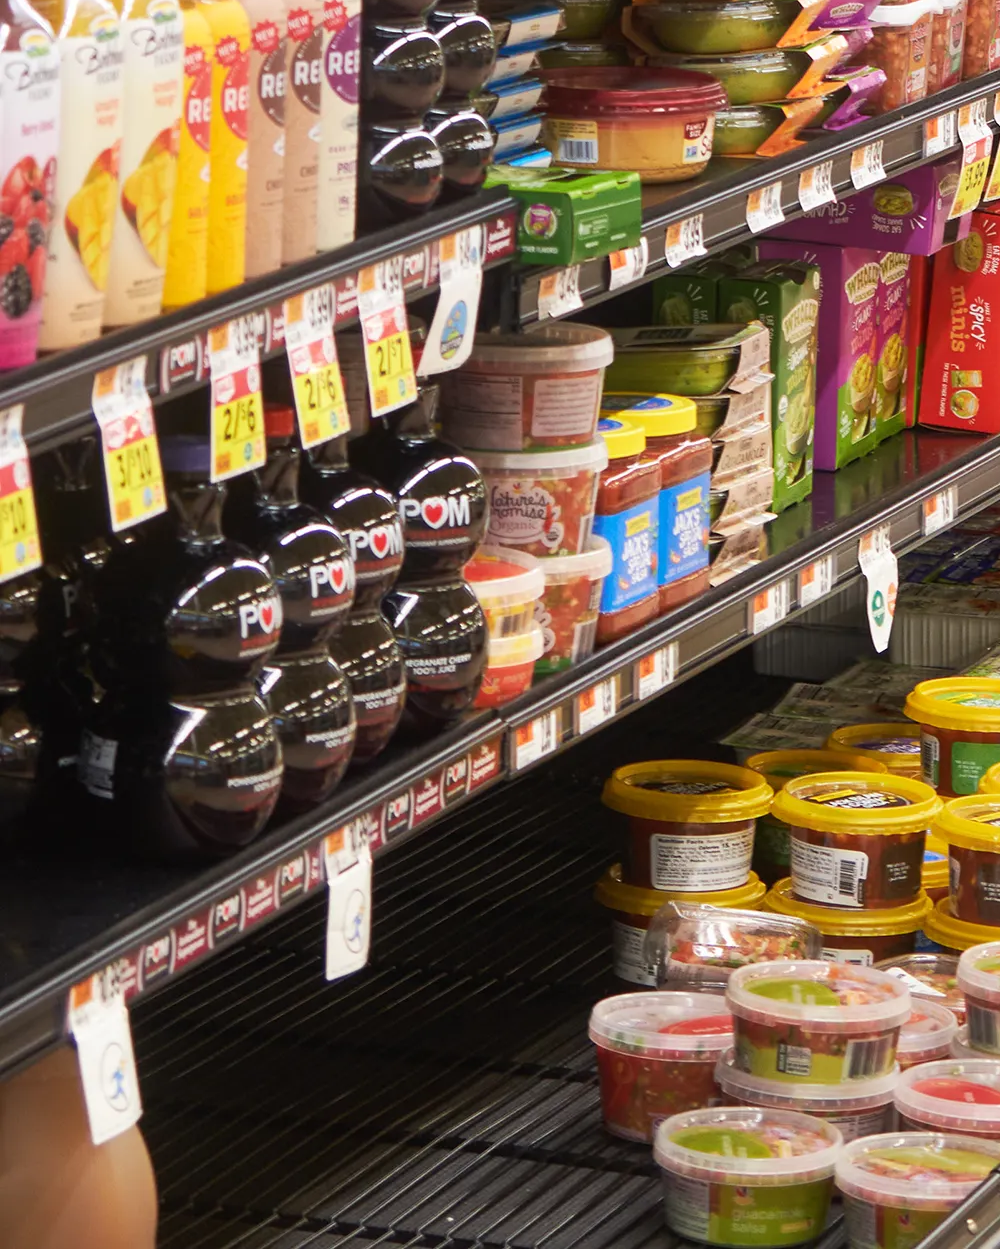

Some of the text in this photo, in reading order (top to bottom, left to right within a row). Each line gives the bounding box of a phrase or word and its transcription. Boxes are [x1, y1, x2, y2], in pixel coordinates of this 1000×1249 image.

[324, 6, 345, 22] NEW
[288, 16, 310, 31] NEW
[255, 28, 277, 44] NEW
[218, 41, 238, 58] NEW
[950, 285, 972, 353] minis
[969, 302, 987, 344] SPICY
[400, 495, 471, 530] POM
[412, 664, 436, 676] 100%
[731, 1222, 767, 1234] salsa
